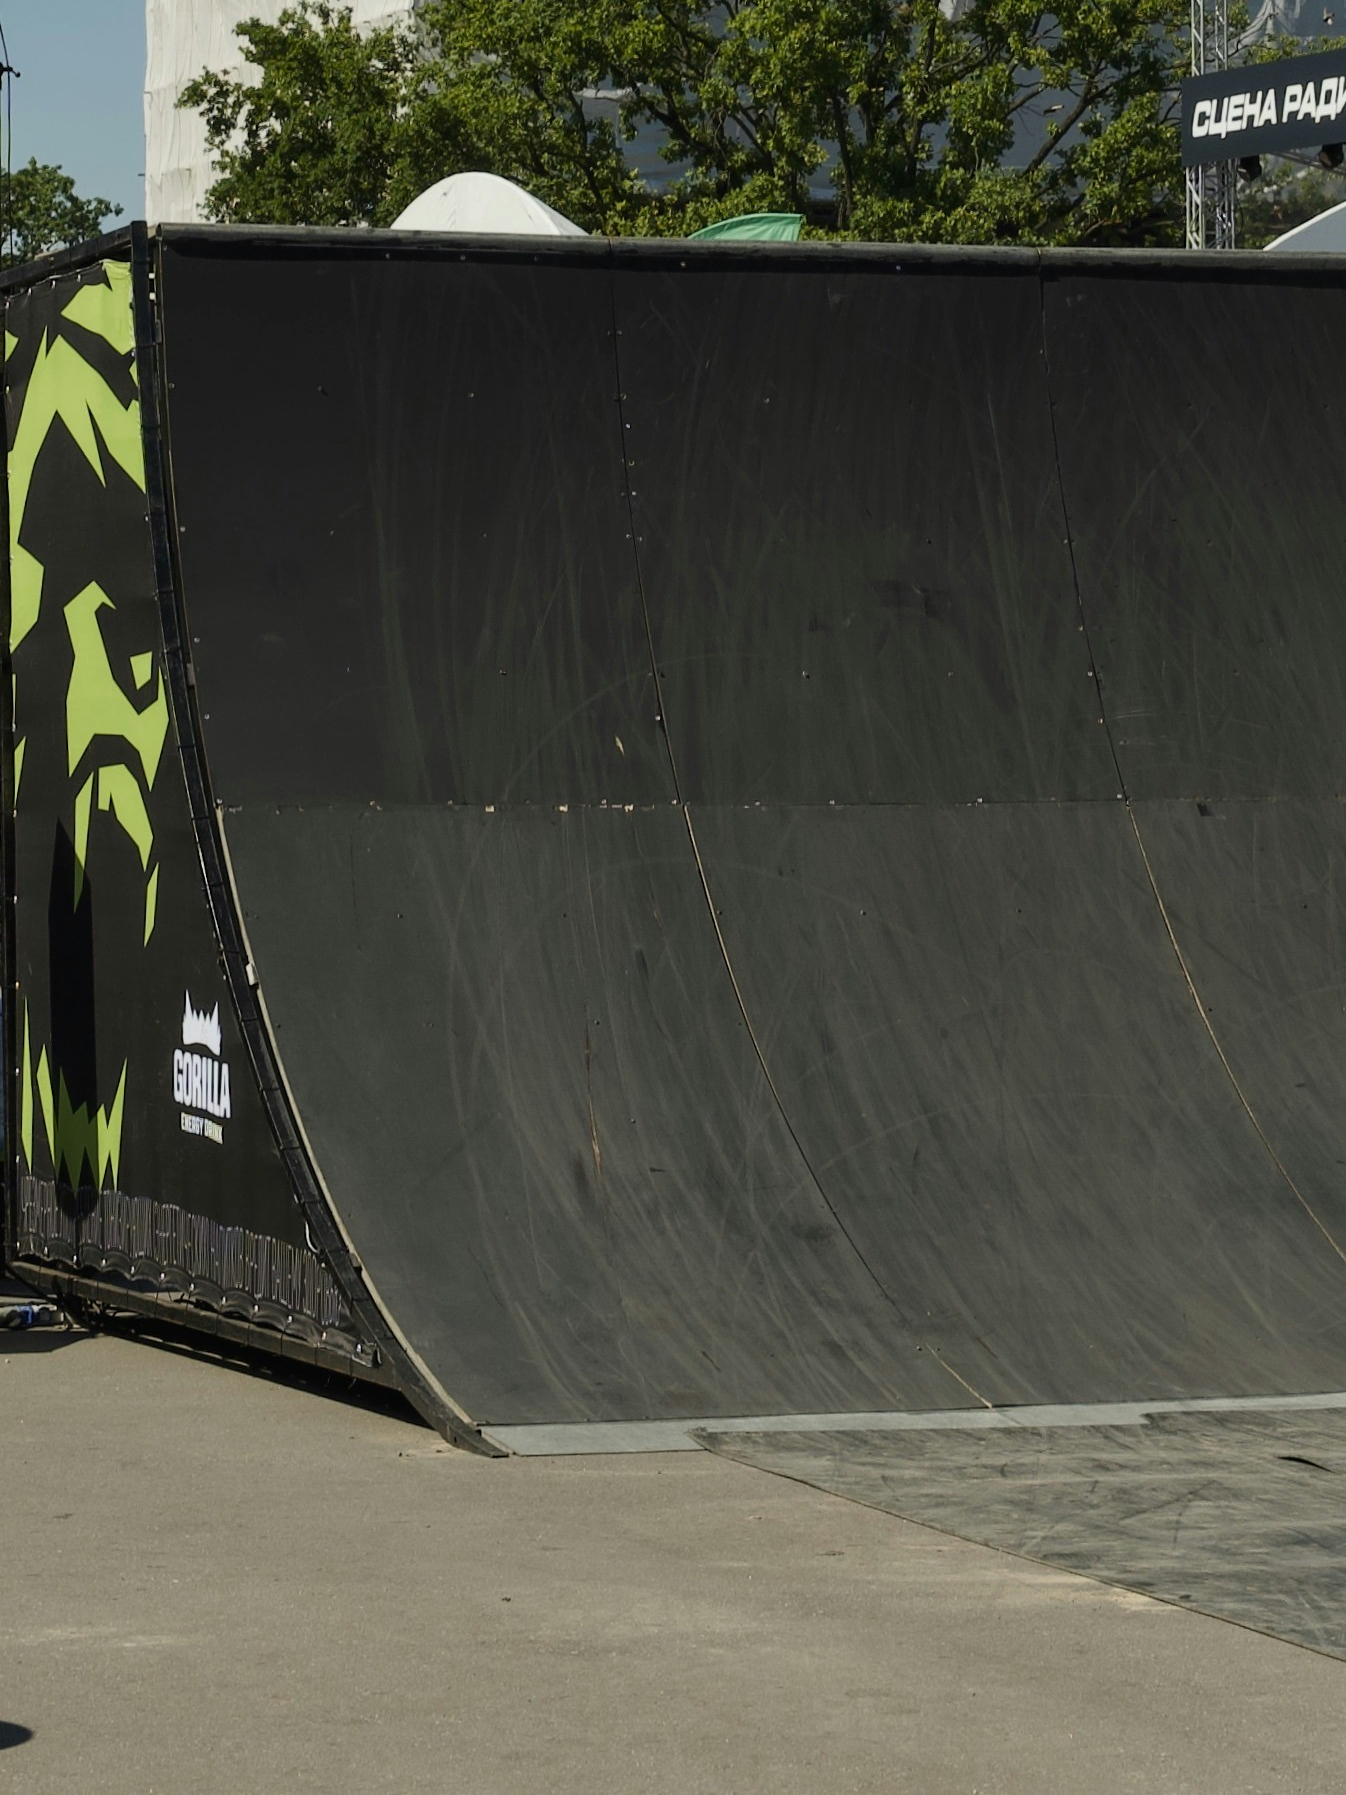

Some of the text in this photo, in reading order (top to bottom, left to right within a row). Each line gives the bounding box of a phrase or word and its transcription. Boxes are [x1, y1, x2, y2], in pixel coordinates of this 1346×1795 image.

[1192, 87, 1278, 139] СЦЕНА
[172, 1048, 232, 1119] GORILLA
[179, 1110, 204, 1137] ENERGY
